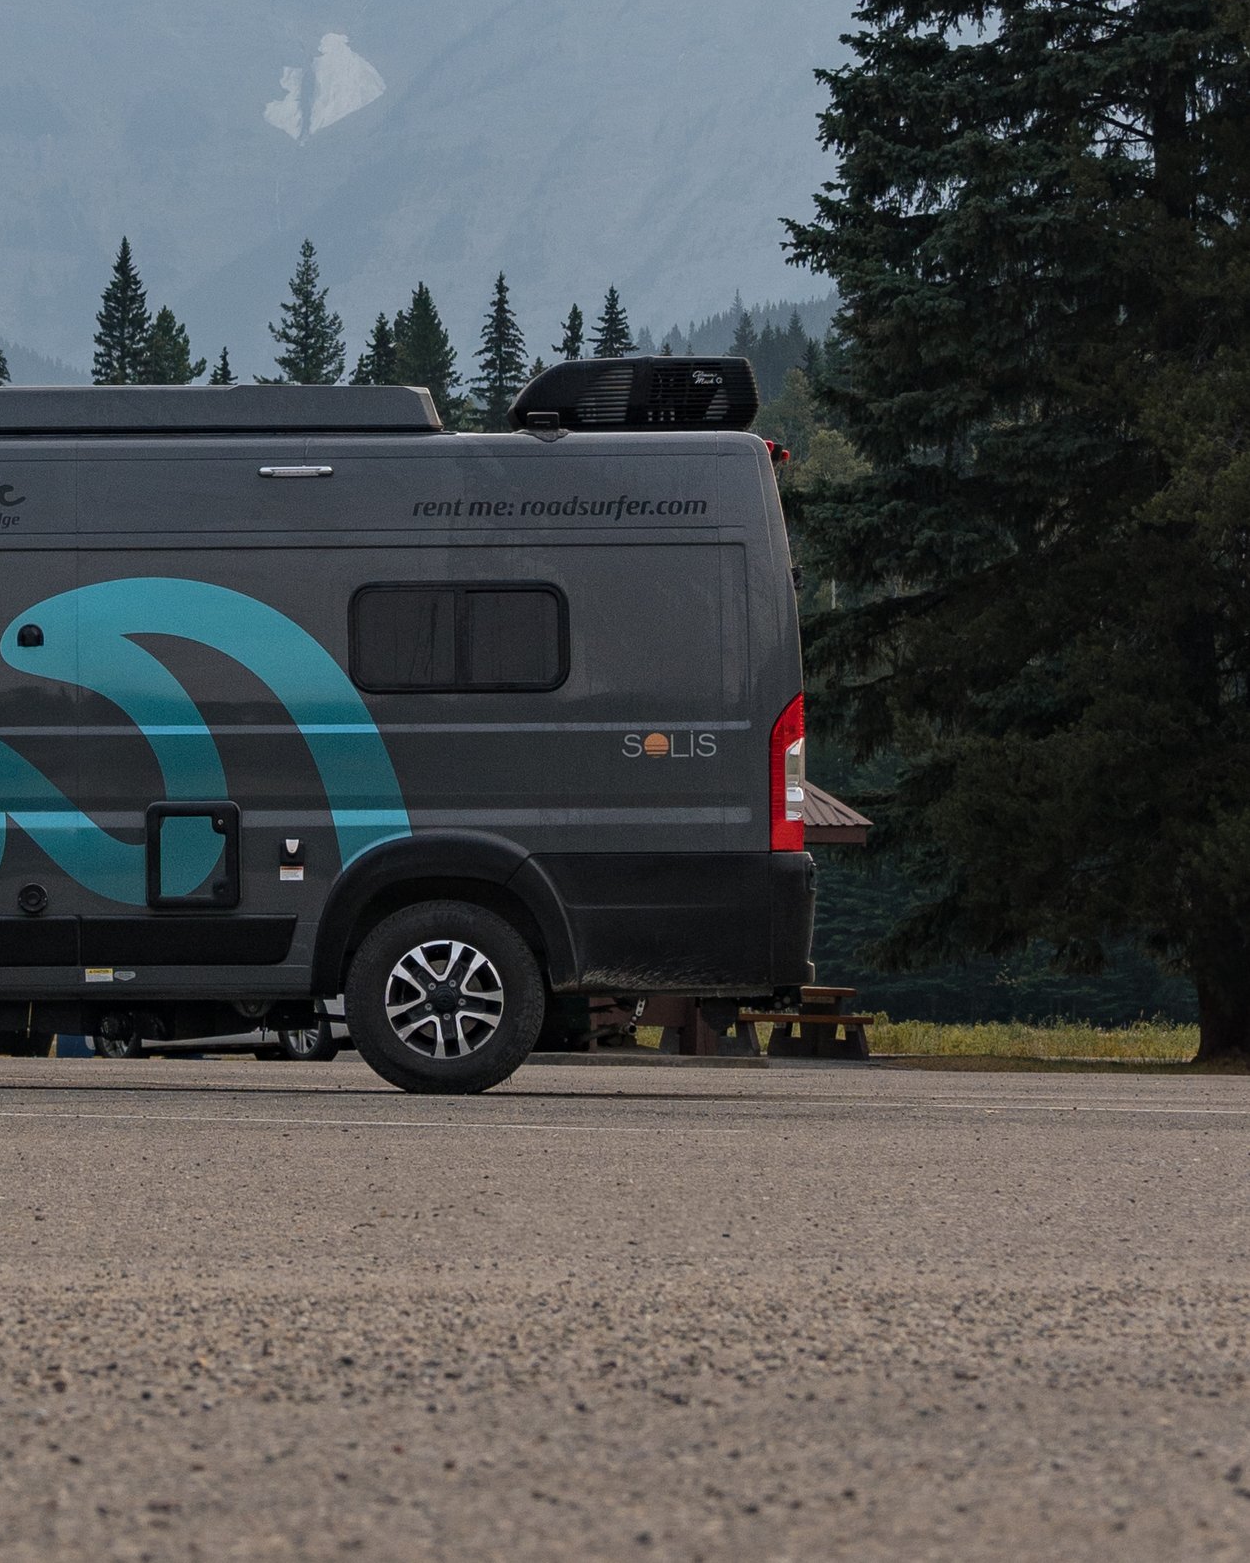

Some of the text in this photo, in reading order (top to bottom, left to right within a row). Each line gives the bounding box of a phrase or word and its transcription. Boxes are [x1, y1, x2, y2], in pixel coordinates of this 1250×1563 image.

[412, 494, 708, 521] rent me: roadsurfer.com
